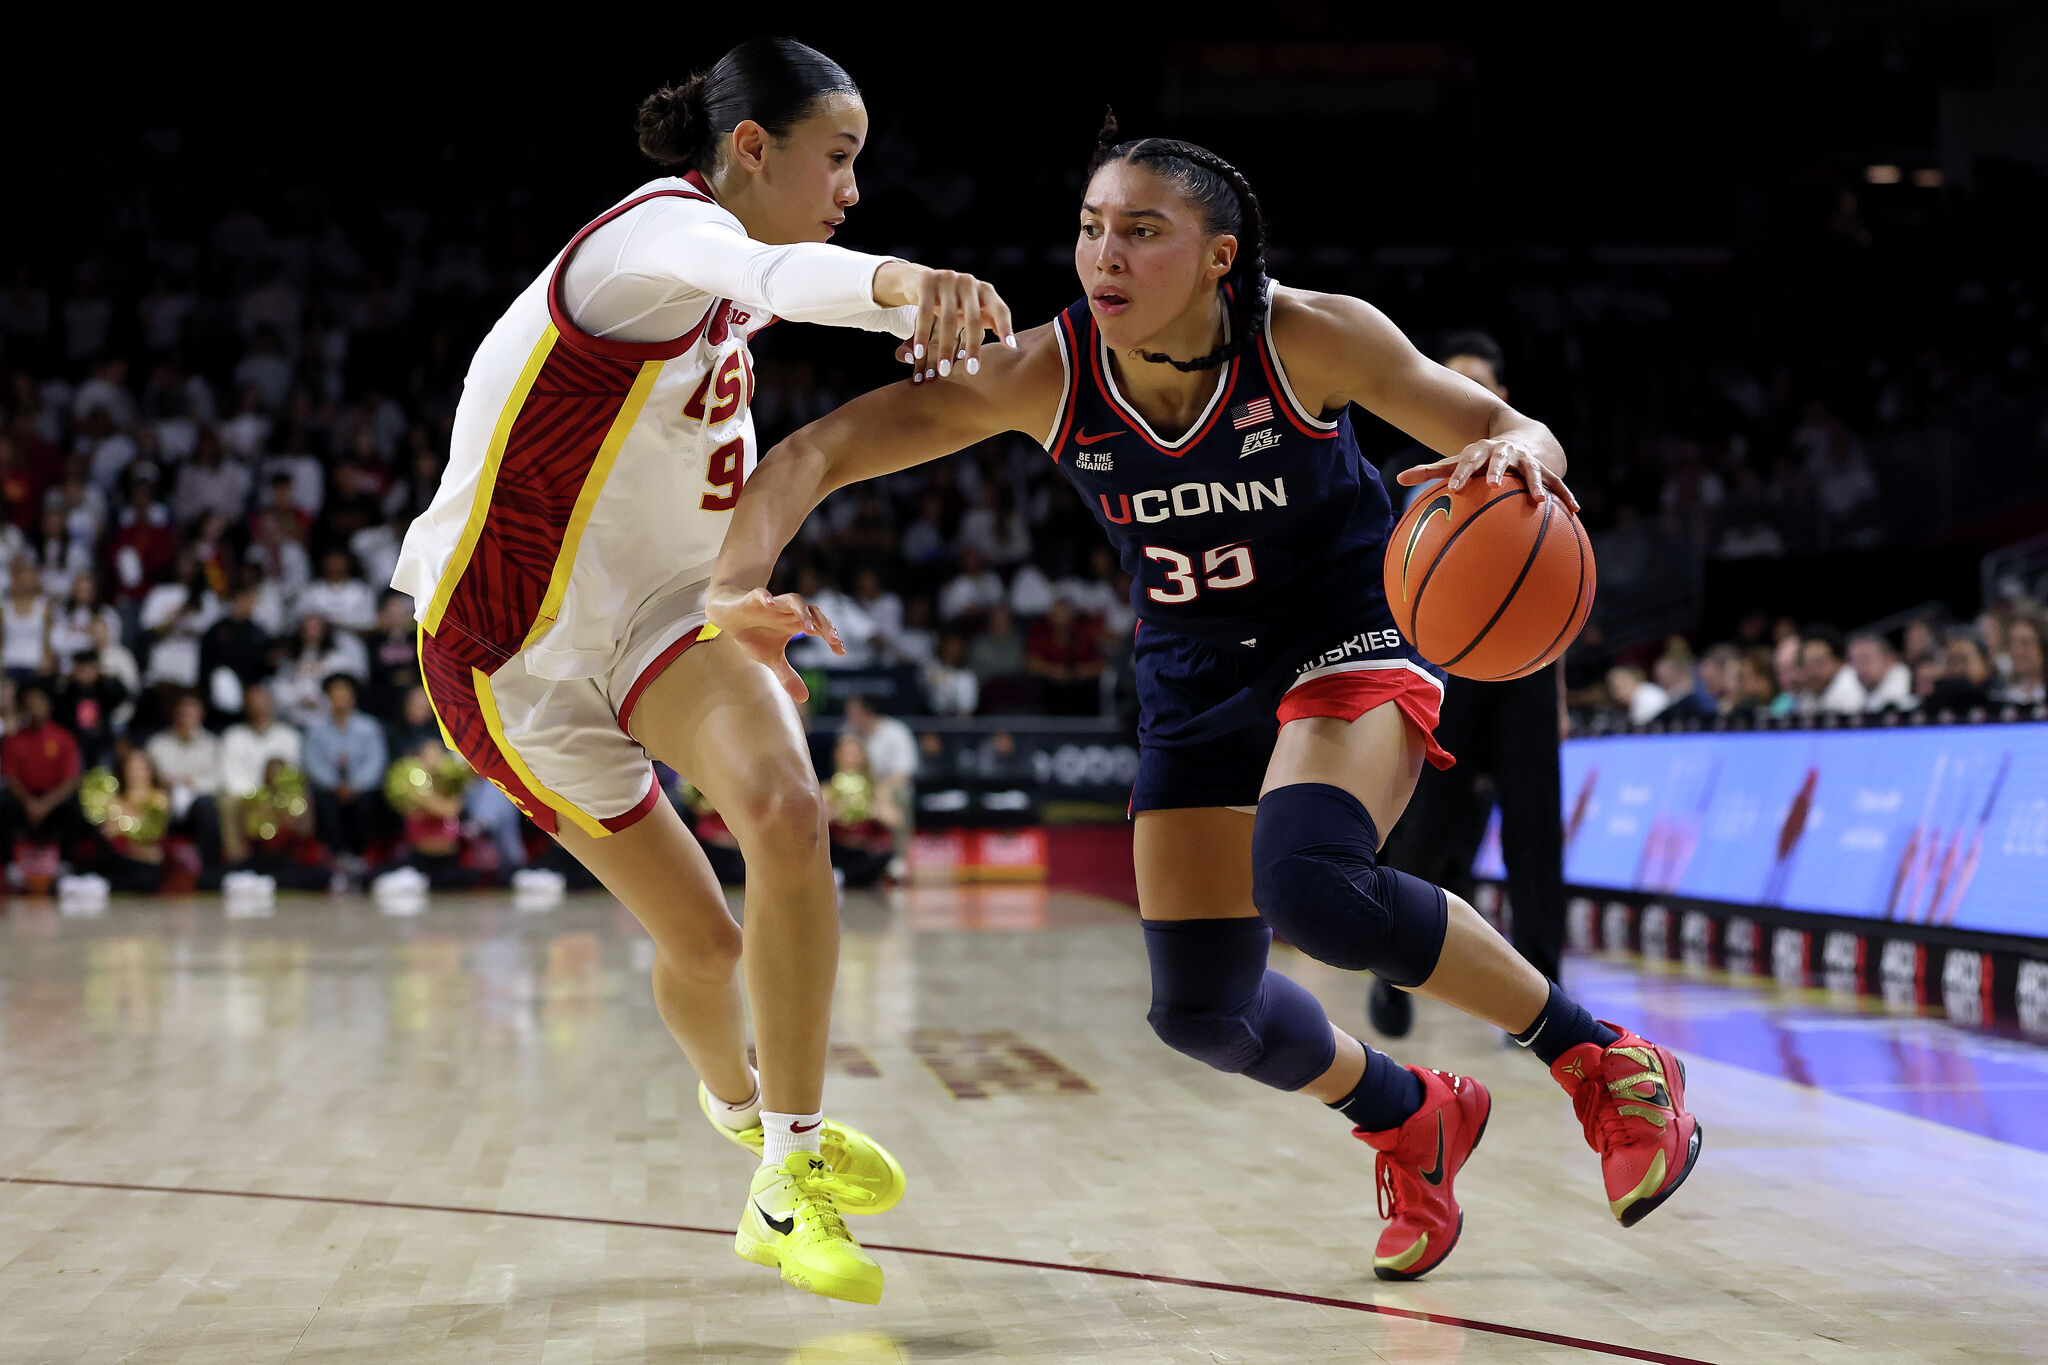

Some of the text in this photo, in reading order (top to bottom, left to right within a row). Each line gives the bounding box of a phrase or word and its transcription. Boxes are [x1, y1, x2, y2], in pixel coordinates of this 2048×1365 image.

[1241, 434, 1282, 453] EAST
[1244, 428, 1273, 445] BIG
[1076, 460, 1114, 471] CHANGE
[1079, 452, 1112, 462] BE THE
[699, 435, 745, 512] 9
[1099, 477, 1288, 525] UCONN
[1143, 539, 1256, 605] 35
